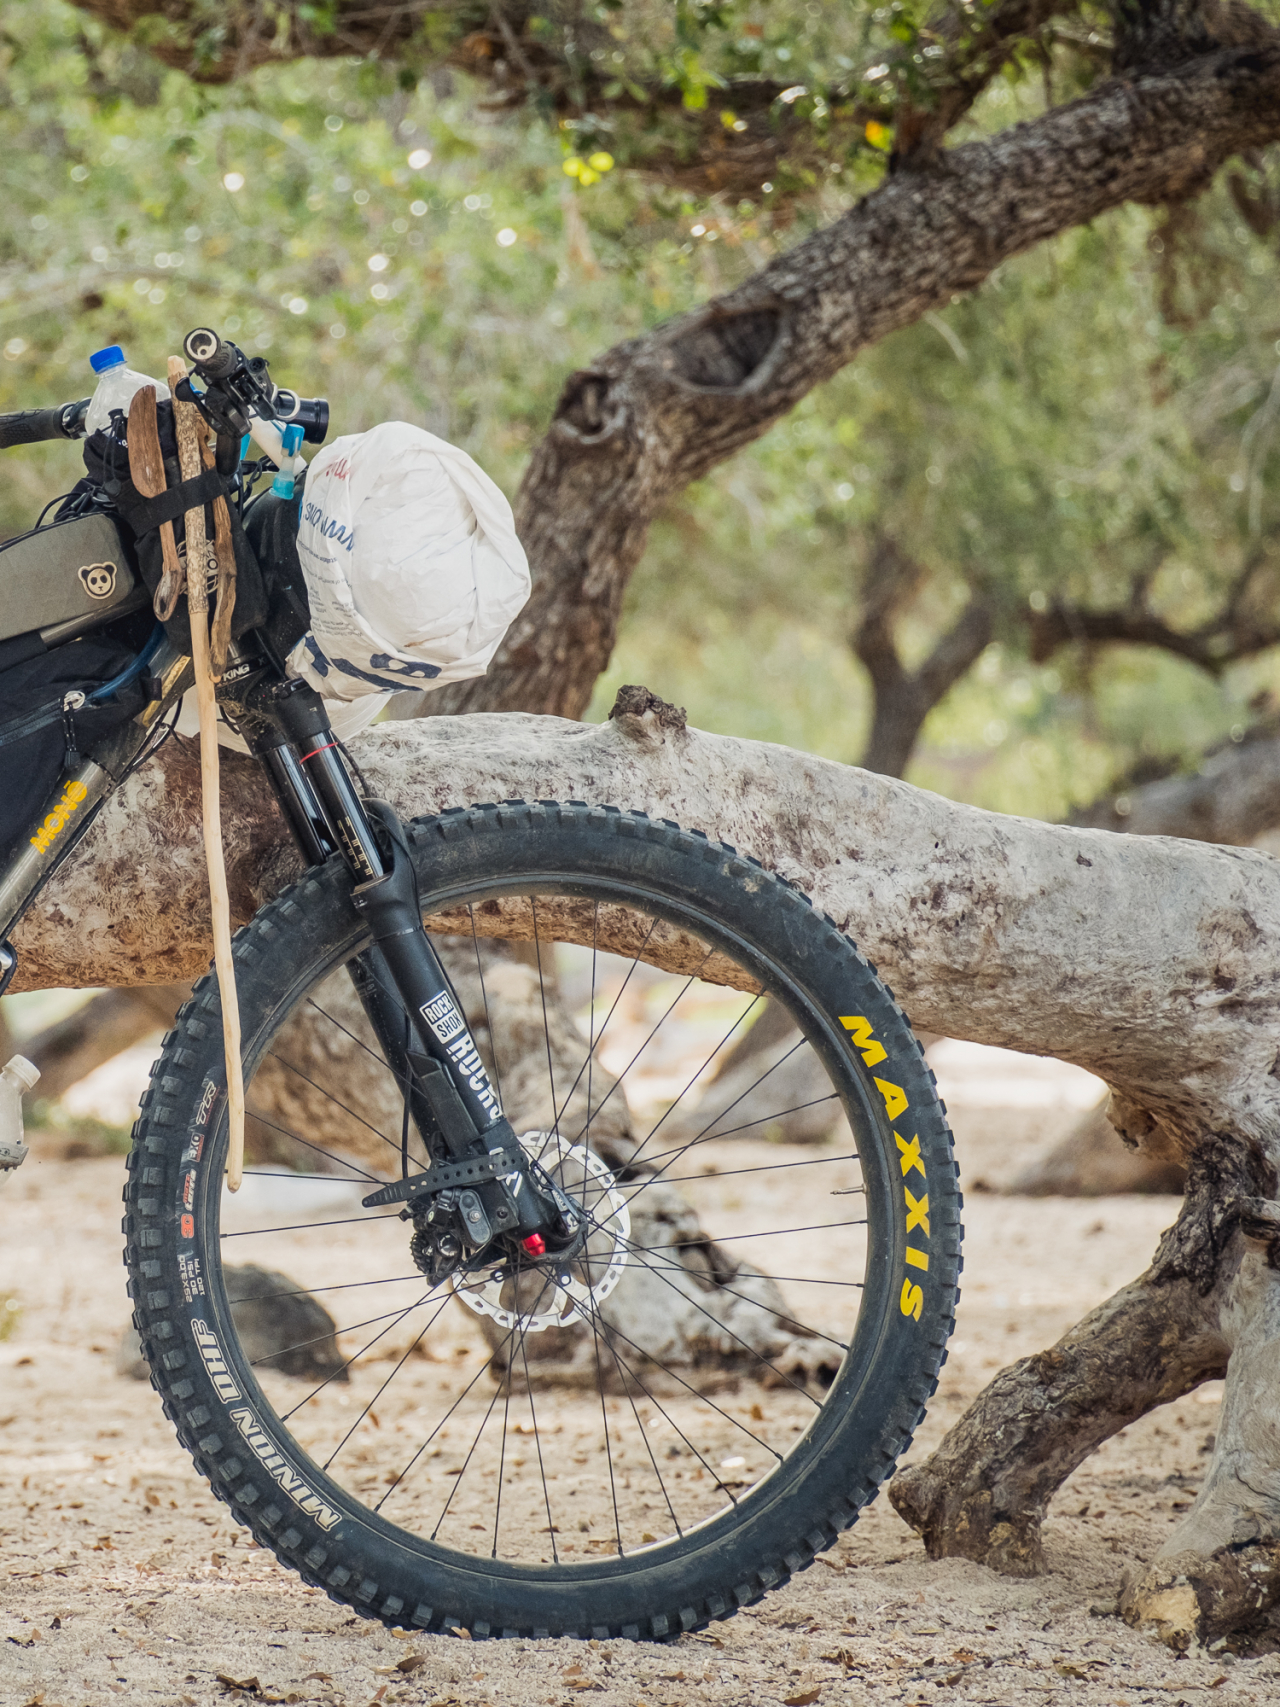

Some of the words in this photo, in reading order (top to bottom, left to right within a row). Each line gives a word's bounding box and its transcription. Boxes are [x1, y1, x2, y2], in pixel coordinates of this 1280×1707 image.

[222, 663, 250, 681] KING
[424, 994, 454, 1023] ROCK
[436, 1011, 463, 1038] SHOX
[196, 1081, 216, 1124] TR
[189, 1133, 201, 1160] EXO
[838, 1015, 930, 1322] MAXXIS
[187, 1261, 195, 1278] PSI
[190, 1280, 199, 1295] 30
[197, 1277, 205, 1296] 120
[191, 1318, 241, 1404] DHF
[229, 1407, 342, 1532] MINION
